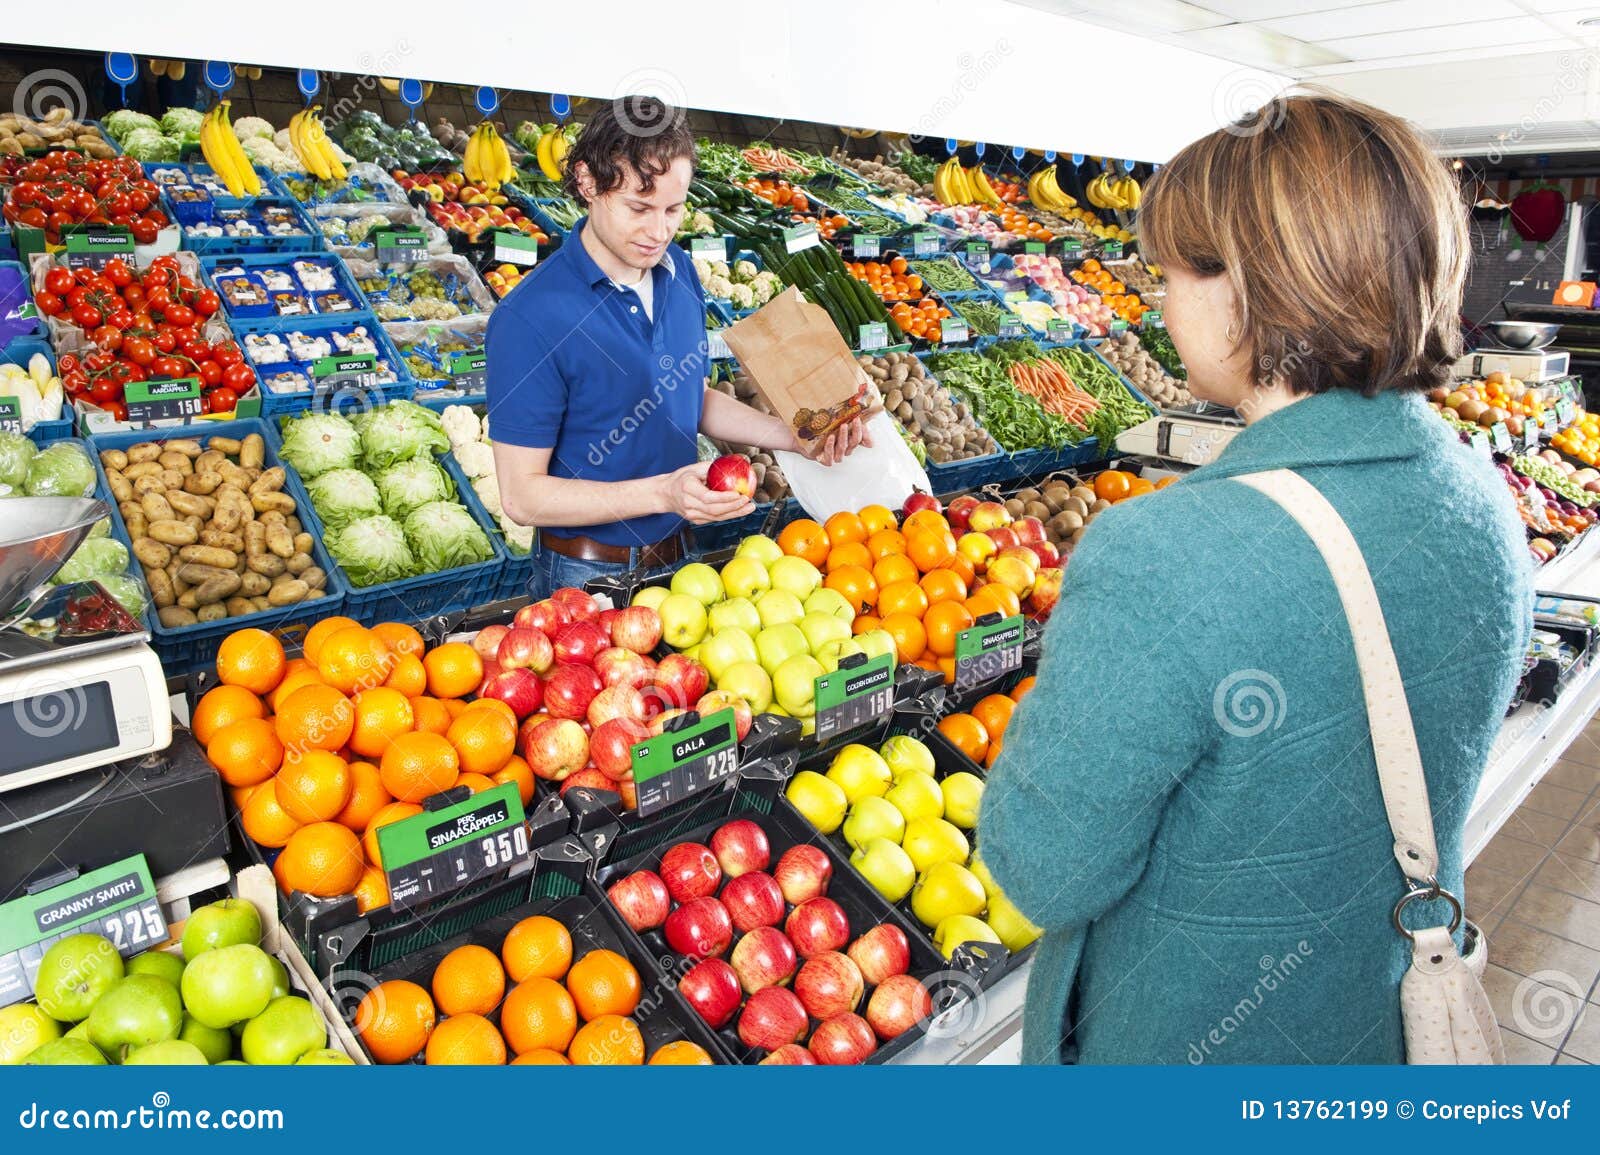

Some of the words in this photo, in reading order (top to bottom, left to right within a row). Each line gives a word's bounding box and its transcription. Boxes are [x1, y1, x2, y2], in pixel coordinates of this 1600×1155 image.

[412, 249, 428, 261] 225
[357, 372, 377, 387] 150
[178, 398, 202, 415] 150
[1001, 644, 1023, 669] 350
[870, 687, 893, 716] 150
[676, 737, 706, 757] GALA
[707, 747, 737, 781] 225
[430, 810, 505, 848] SINAASAPPELS
[457, 812, 477, 827] PERS
[482, 826, 529, 868] 350
[40, 895, 94, 925] GRANNY
[96, 879, 137, 903] SMITH
[392, 884, 420, 901] Spanje
[105, 905, 165, 950] 225
